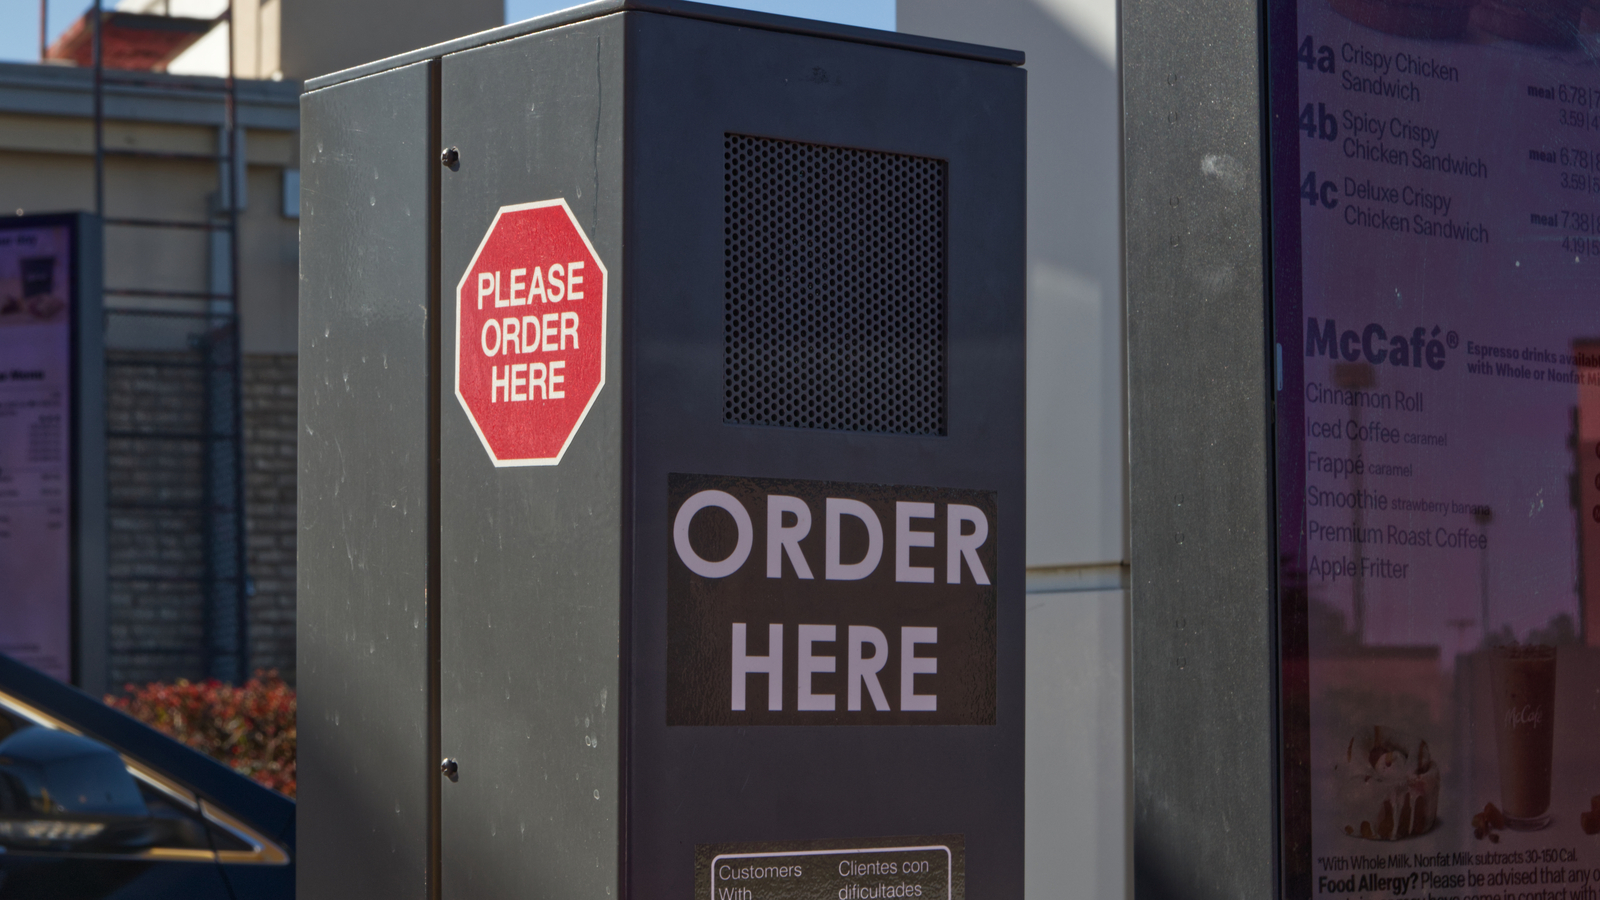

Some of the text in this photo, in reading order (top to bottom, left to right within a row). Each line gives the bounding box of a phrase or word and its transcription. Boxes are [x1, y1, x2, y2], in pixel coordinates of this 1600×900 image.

[1298, 35, 1335, 74] 4a
[1341, 42, 1459, 82] Crispy Chicken
[1341, 69, 1420, 102] Sandwich
[1527, 85, 1555, 100] meal
[1299, 102, 1338, 142] 4b
[1342, 109, 1440, 149] Spicy Crispy
[1343, 137, 1488, 179] Chicken Sandwich
[1529, 149, 1556, 164] meal
[1299, 171, 1339, 210] 4c
[1344, 177, 1452, 217] Deluxe Crispy
[1344, 204, 1489, 244] Chicken Sandwich
[1530, 212, 1558, 228] meal
[477, 260, 585, 310] PLEASE
[480, 311, 580, 358] ORDER
[1467, 341, 1520, 360] Espresso
[1521, 347, 1558, 364] drinks
[491, 360, 566, 403] HERE
[1467, 360, 1494, 376] with
[1495, 362, 1532, 380] Whole
[1533, 369, 1545, 381] or
[1547, 368, 1586, 386] Nonfat
[1305, 382, 1424, 413] Cinnamon Roll
[1307, 416, 1447, 447] Iced Coffee caramel
[1307, 451, 1413, 479] Frappé caramel
[1307, 485, 1491, 517] Smoothie strawberry banana
[673, 489, 992, 586] ORDER
[1309, 520, 1488, 550] Premium Roast Coffee
[1308, 555, 1409, 582] Apple Fritter
[731, 622, 938, 712] HERE
[718, 863, 803, 881] Customers
[838, 859, 929, 877] Clientes con
[1350, 854, 1386, 870] Whole
[1413, 852, 1451, 868] Nonfat
[1452, 851, 1474, 867] Milk
[1475, 850, 1524, 866] subtracts
[1525, 848, 1558, 864] 30-150
[1559, 847, 1578, 862] Cal.
[718, 887, 752, 900] With
[838, 882, 923, 900] dificultades
[1318, 874, 1356, 894] Food
[1357, 872, 1419, 896] Allergy?
[1421, 871, 1466, 889] Please
[1467, 869, 1485, 887] be
[1487, 867, 1538, 886] advised
[1540, 866, 1566, 884] that
[1568, 868, 1591, 888] any
